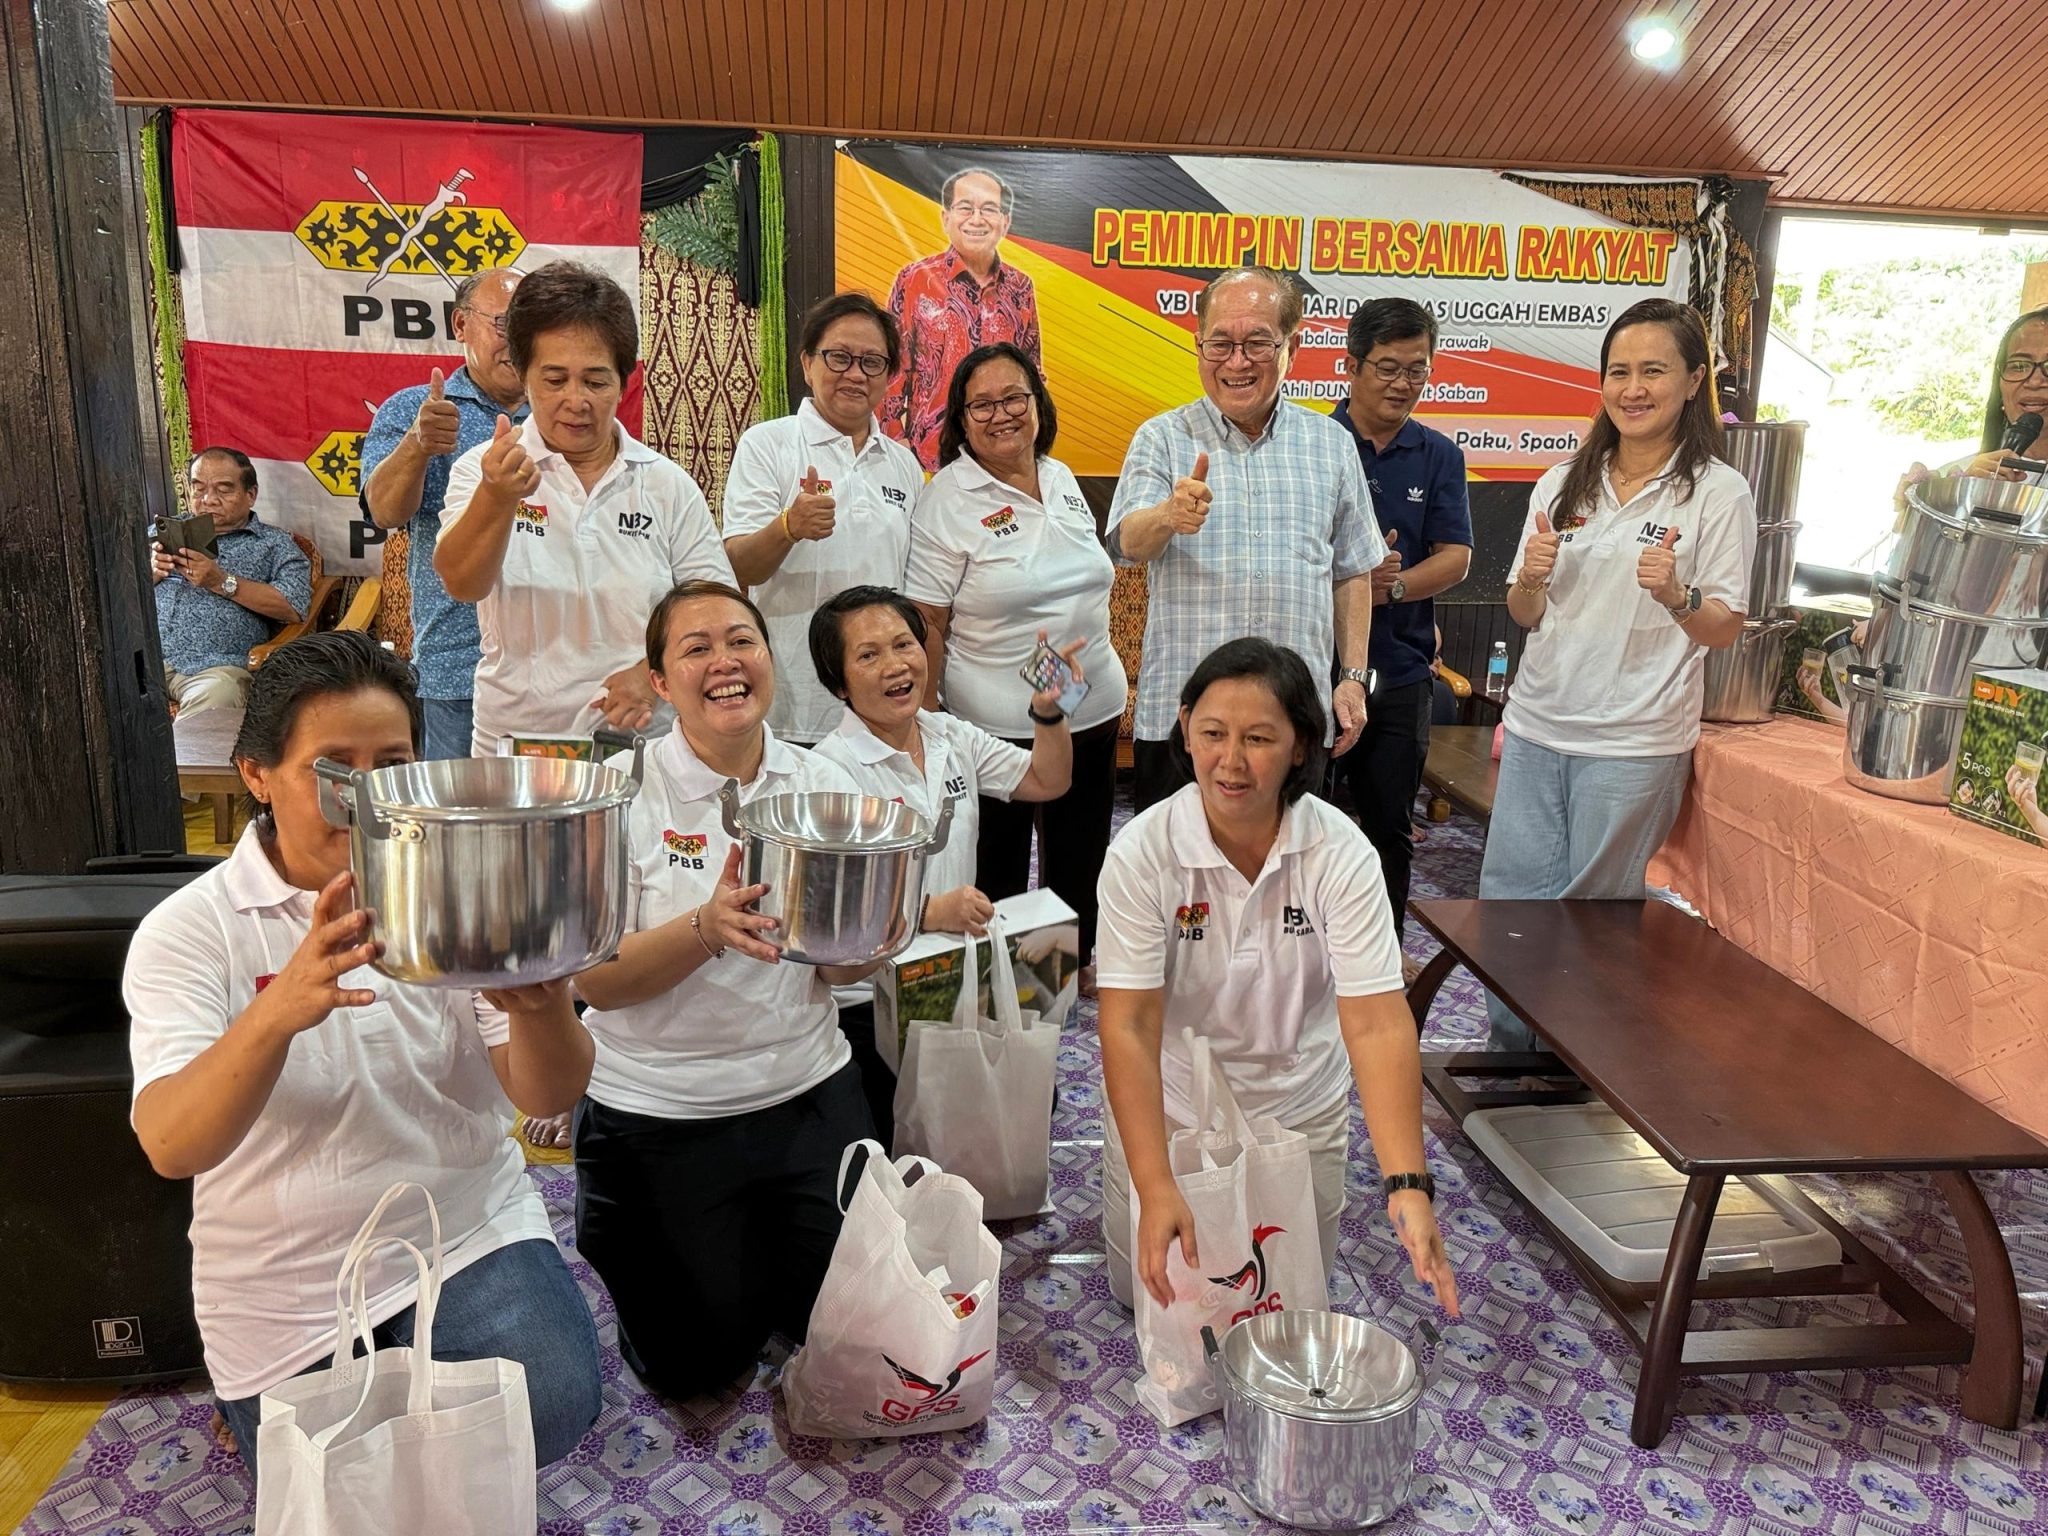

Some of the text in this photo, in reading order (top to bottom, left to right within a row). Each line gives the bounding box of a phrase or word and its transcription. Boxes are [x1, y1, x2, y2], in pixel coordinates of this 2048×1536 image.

[1093, 209, 1679, 286] PEMIMPIN BERSAMA RAKYAT
[1159, 292, 1188, 312] YB
[1454, 302, 1527, 322] UGGAH
[1537, 304, 1608, 324] EMBAS
[1281, 383, 1309, 397] Ahli
[1314, 383, 1351, 398] DUN
[1438, 386, 1486, 400] Saban
[1455, 431, 1579, 452] Paku, Spaoh
[882, 486, 907, 504] N37
[516, 521, 545, 537] PBB
[618, 512, 653, 531] N37
[994, 523, 1019, 538] PBB
[1974, 680, 2028, 708] DIY
[1961, 752, 1992, 777] 5 PCS
[669, 854, 704, 870] PBB
[902, 952, 957, 982] DIY
[882, 1393, 961, 1421] GPS
